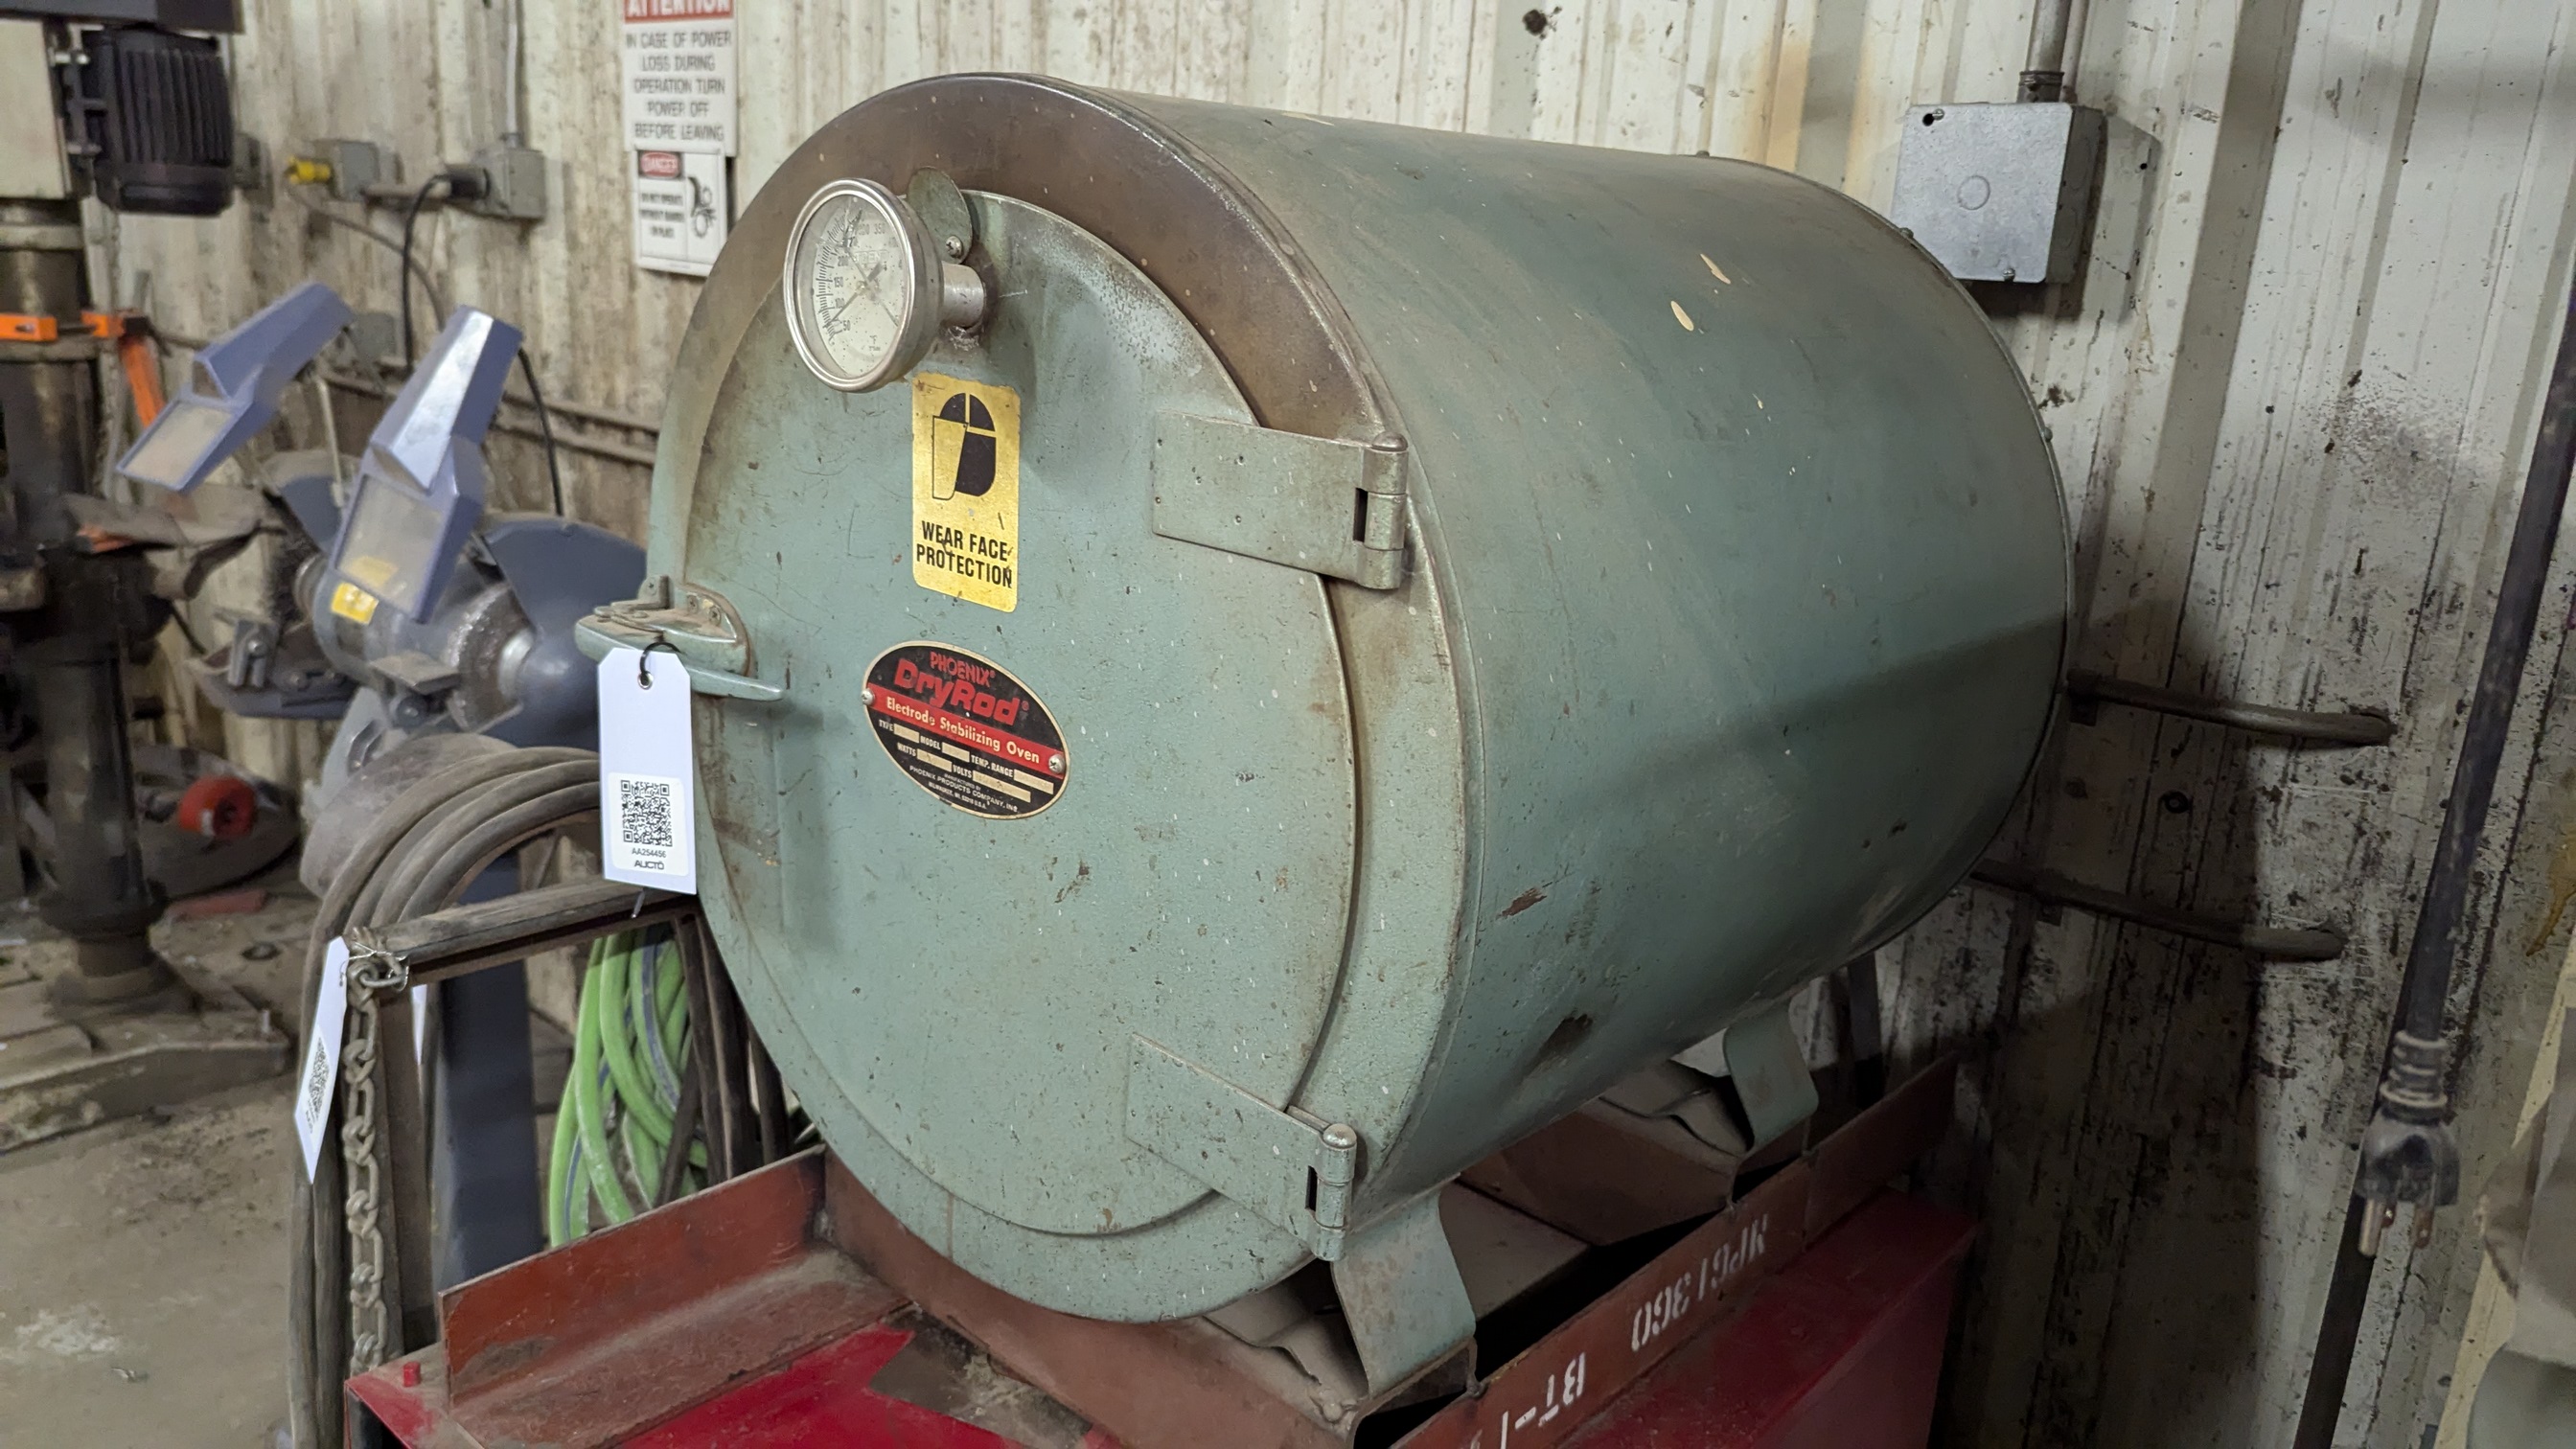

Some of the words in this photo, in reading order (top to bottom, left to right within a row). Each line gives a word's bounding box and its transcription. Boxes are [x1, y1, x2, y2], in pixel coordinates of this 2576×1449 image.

[626, 34, 636, 48] IN
[640, 33, 667, 48] CASE
[673, 32, 686, 48] OF
[691, 31, 731, 47] POWER
[642, 55, 670, 71] LOSS
[675, 54, 715, 71] DURING
[633, 78, 692, 94] OPERATION
[696, 78, 725, 94] TURN
[647, 102, 684, 116] POWER
[690, 102, 708, 117] OFF
[634, 123, 676, 139] BEFORE
[681, 125, 724, 141] LEAVING
[922, 520, 963, 550] WEAR
[969, 533, 1008, 562] FACE
[916, 542, 1013, 588] PROTECTION
[886, 696, 936, 726] Electrode
[940, 717, 1000, 752] Stabilizing
[1006, 741, 1040, 764] Oven
[878, 719, 894, 731] TYPE
[920, 735, 941, 750] MODEL
[971, 754, 990, 770] TEMP.
[991, 763, 1013, 778] RANGE
[897, 742, 916, 756] WATTS
[953, 764, 972, 779] VOLTS
[909, 765, 936, 780] PHOENIX
[937, 774, 971, 794] PRODUCTS
[972, 790, 1006, 809] COMPANY,
[632, 847, 667, 859] AA254456
